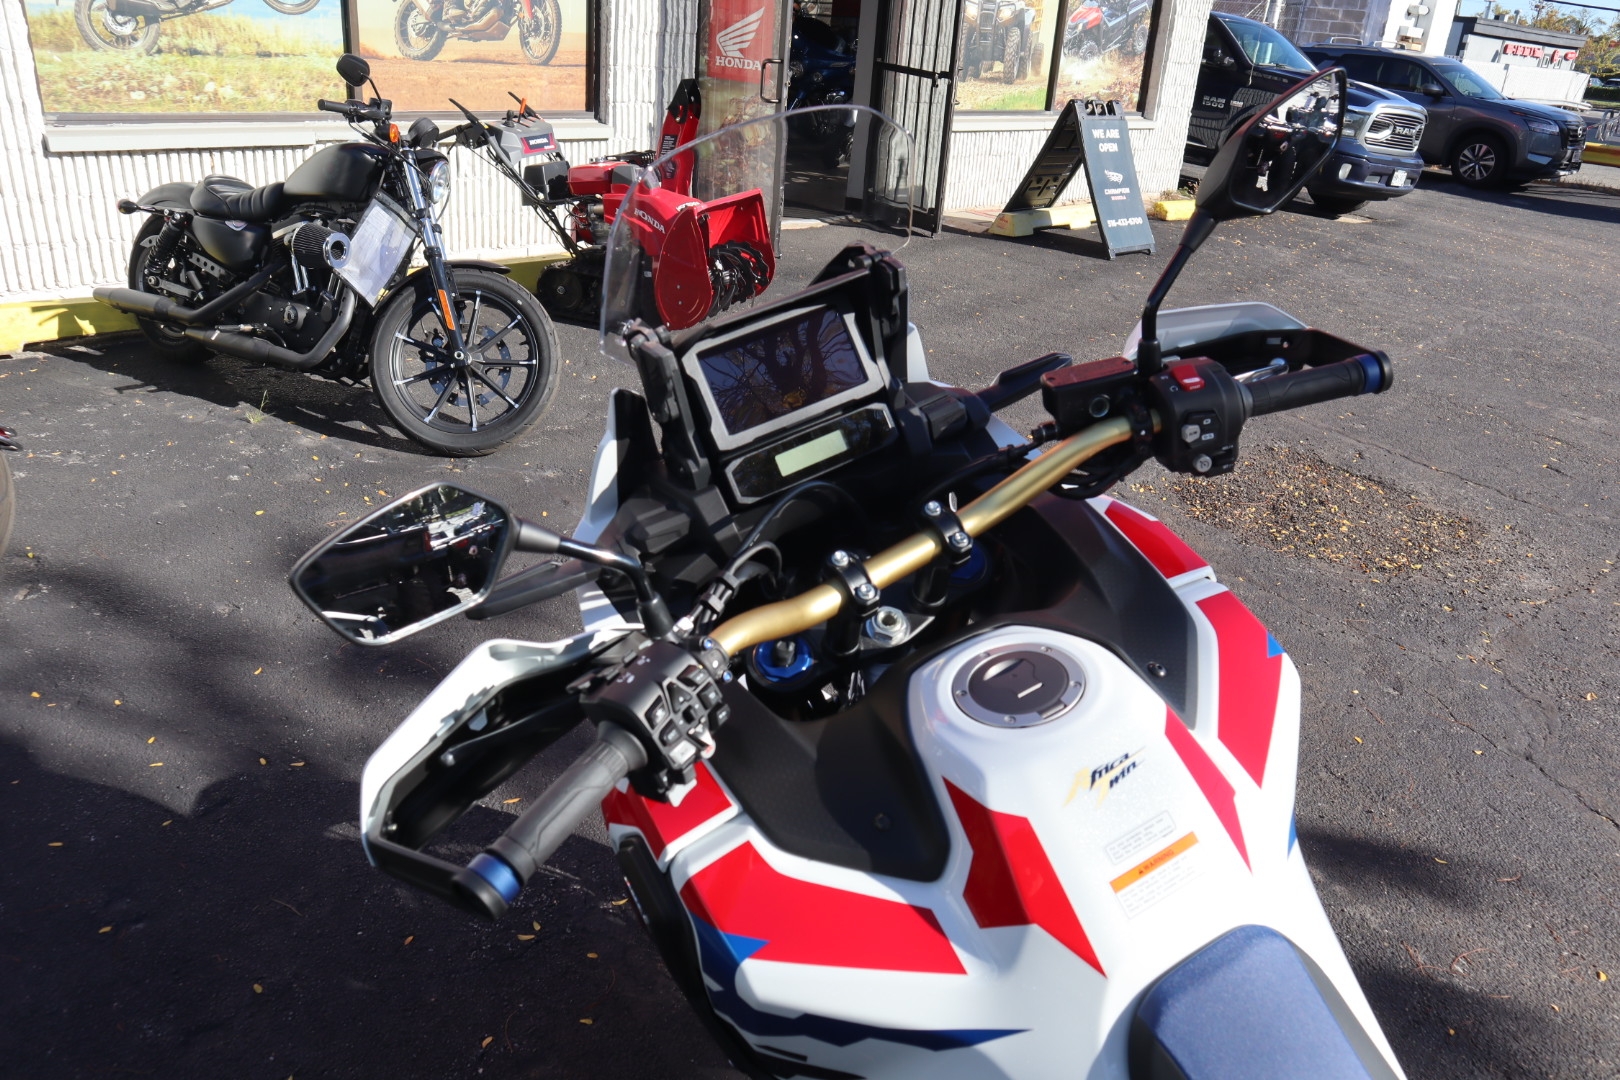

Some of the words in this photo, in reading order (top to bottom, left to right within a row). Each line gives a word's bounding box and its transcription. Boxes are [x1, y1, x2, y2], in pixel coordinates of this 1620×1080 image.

[715, 55, 761, 71] HONDA
[1202, 101, 1225, 109] 1500
[1203, 95, 1226, 104] RAM
[1091, 128, 1105, 139] WE
[1105, 128, 1120, 139] ARE
[1098, 142, 1118, 153] OPEN
[634, 207, 666, 234] HONDA
